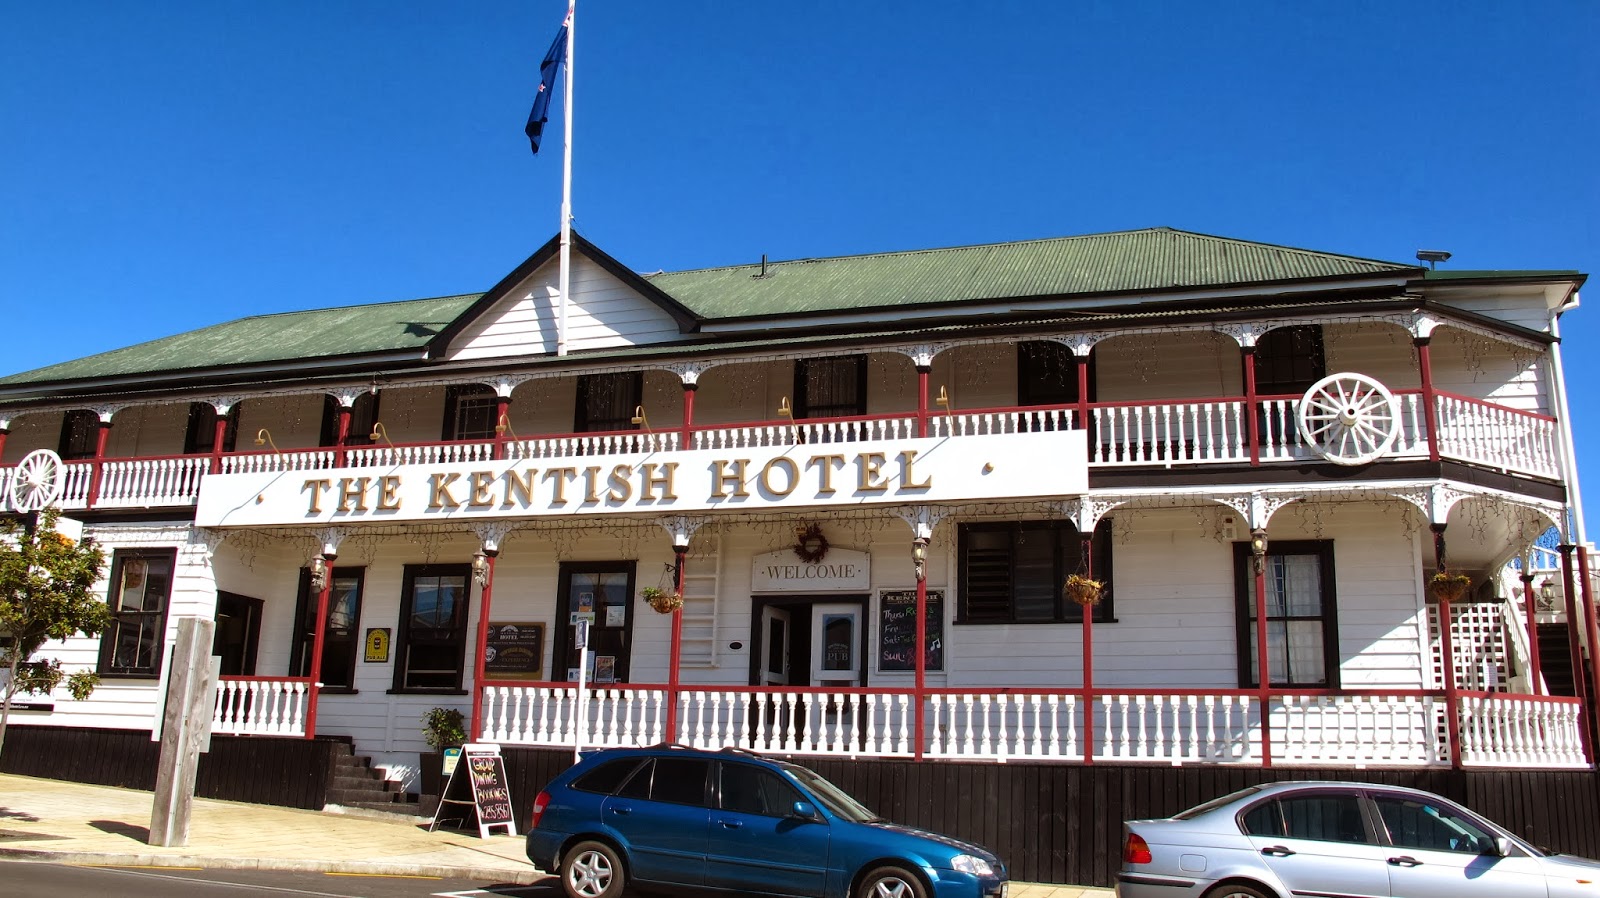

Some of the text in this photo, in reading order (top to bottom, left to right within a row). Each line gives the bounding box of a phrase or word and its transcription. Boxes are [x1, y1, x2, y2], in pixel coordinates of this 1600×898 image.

[302, 449, 933, 514] THE KENTISH HOTEL
[767, 564, 855, 579] WELCOME
[827, 653, 848, 661] PUB
[473, 758, 495, 771] GROUP
[476, 788, 507, 803] BOOKINGS
